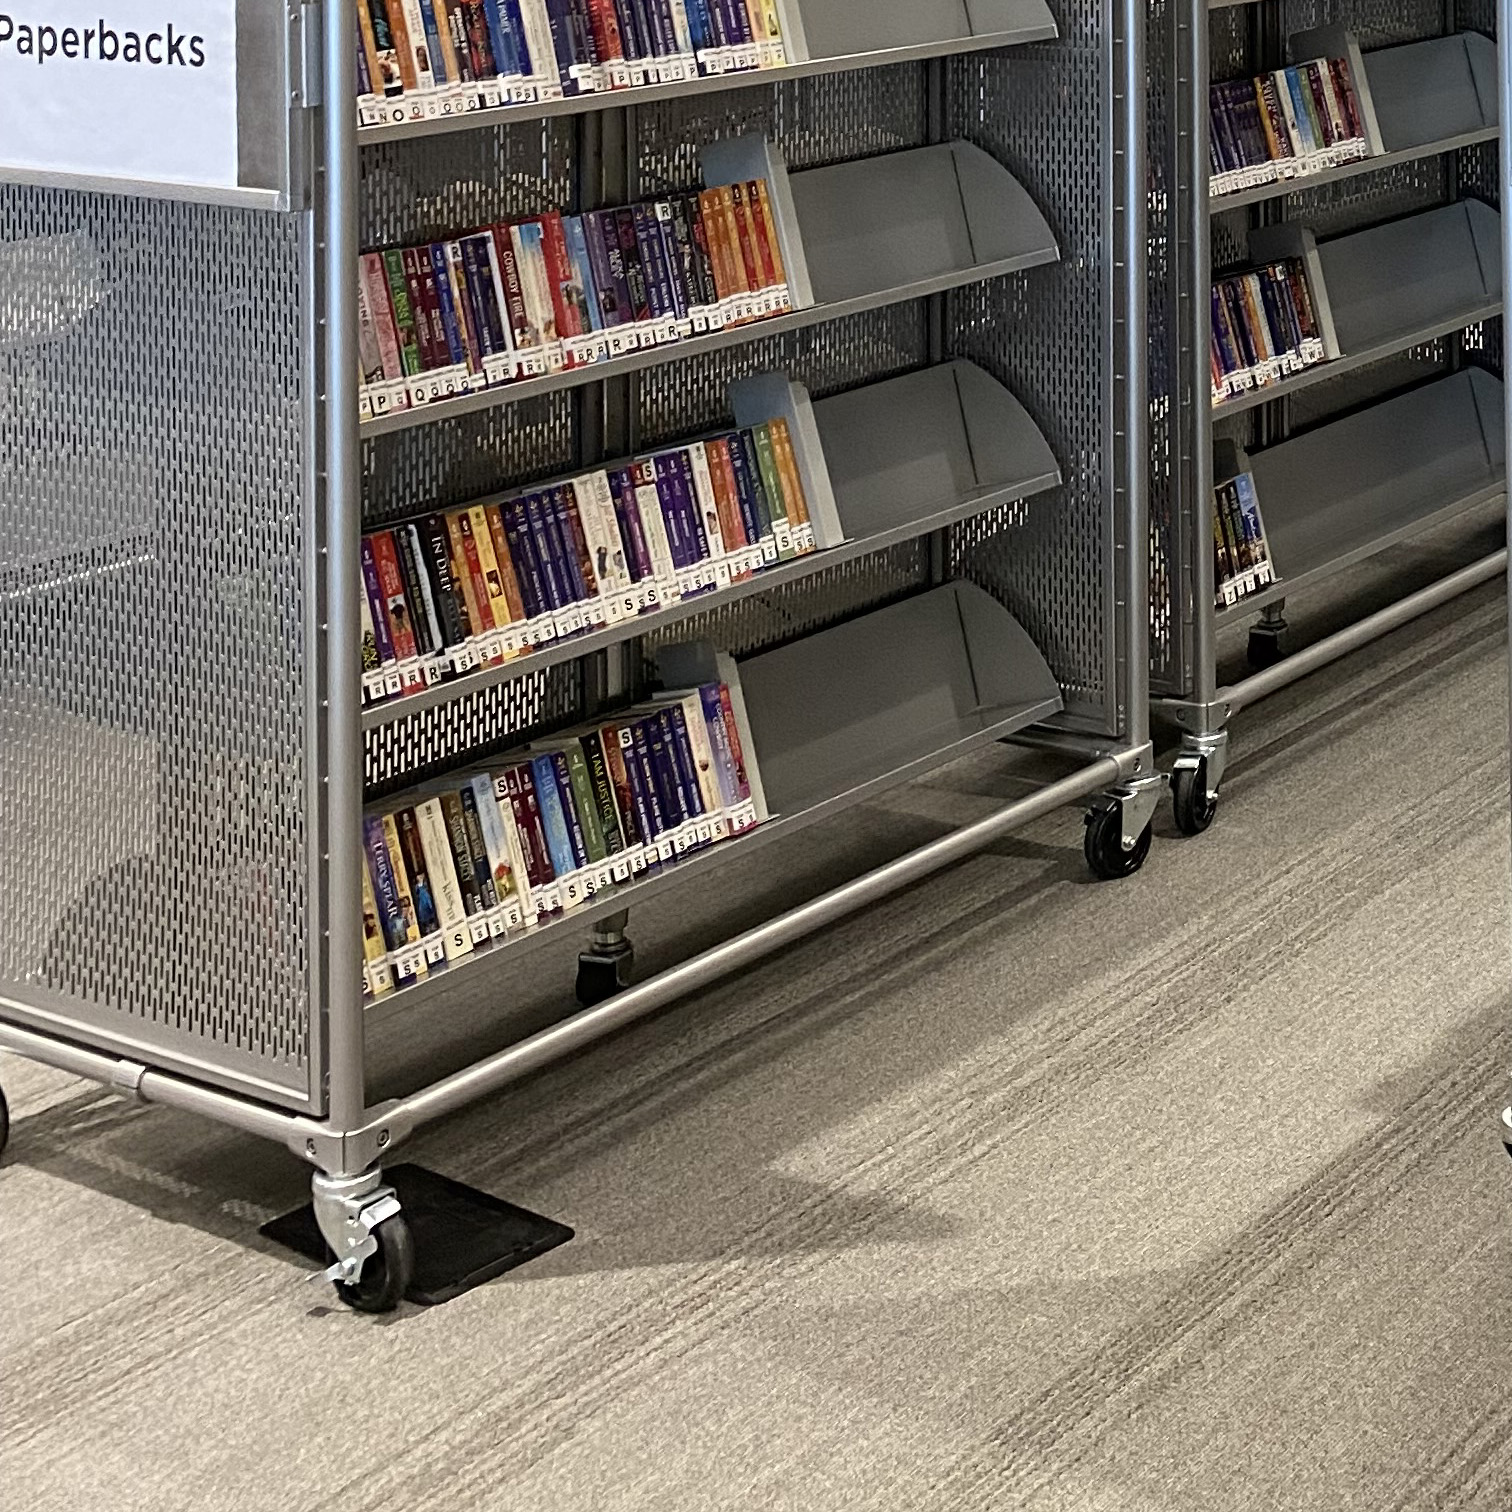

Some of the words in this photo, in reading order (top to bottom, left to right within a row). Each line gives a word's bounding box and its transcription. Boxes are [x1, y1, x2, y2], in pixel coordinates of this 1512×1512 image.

[392, 109, 404, 122] O
[451, 246, 460, 258] R
[502, 250, 519, 294] COWBOY
[509, 295, 525, 318] FIRE
[668, 325, 677, 337] R
[613, 339, 622, 351] R
[586, 348, 594, 360] R
[415, 388, 425, 402] Q
[378, 396, 386, 408] P
[431, 536, 443, 554] IN
[436, 558, 452, 592] DEEP
[647, 589, 657, 602] S
[625, 598, 634, 611] S
[429, 667, 439, 680] R
[622, 732, 630, 745] S
[593, 760, 604, 778] AM
[498, 781, 506, 793] S
[596, 780, 614, 821] JUSTICE
[373, 841, 388, 879] TERRY
[382, 880, 399, 920] SPEAR
[568, 885, 577, 899] S
[586, 882, 595, 895] S
[454, 933, 464, 947] S
